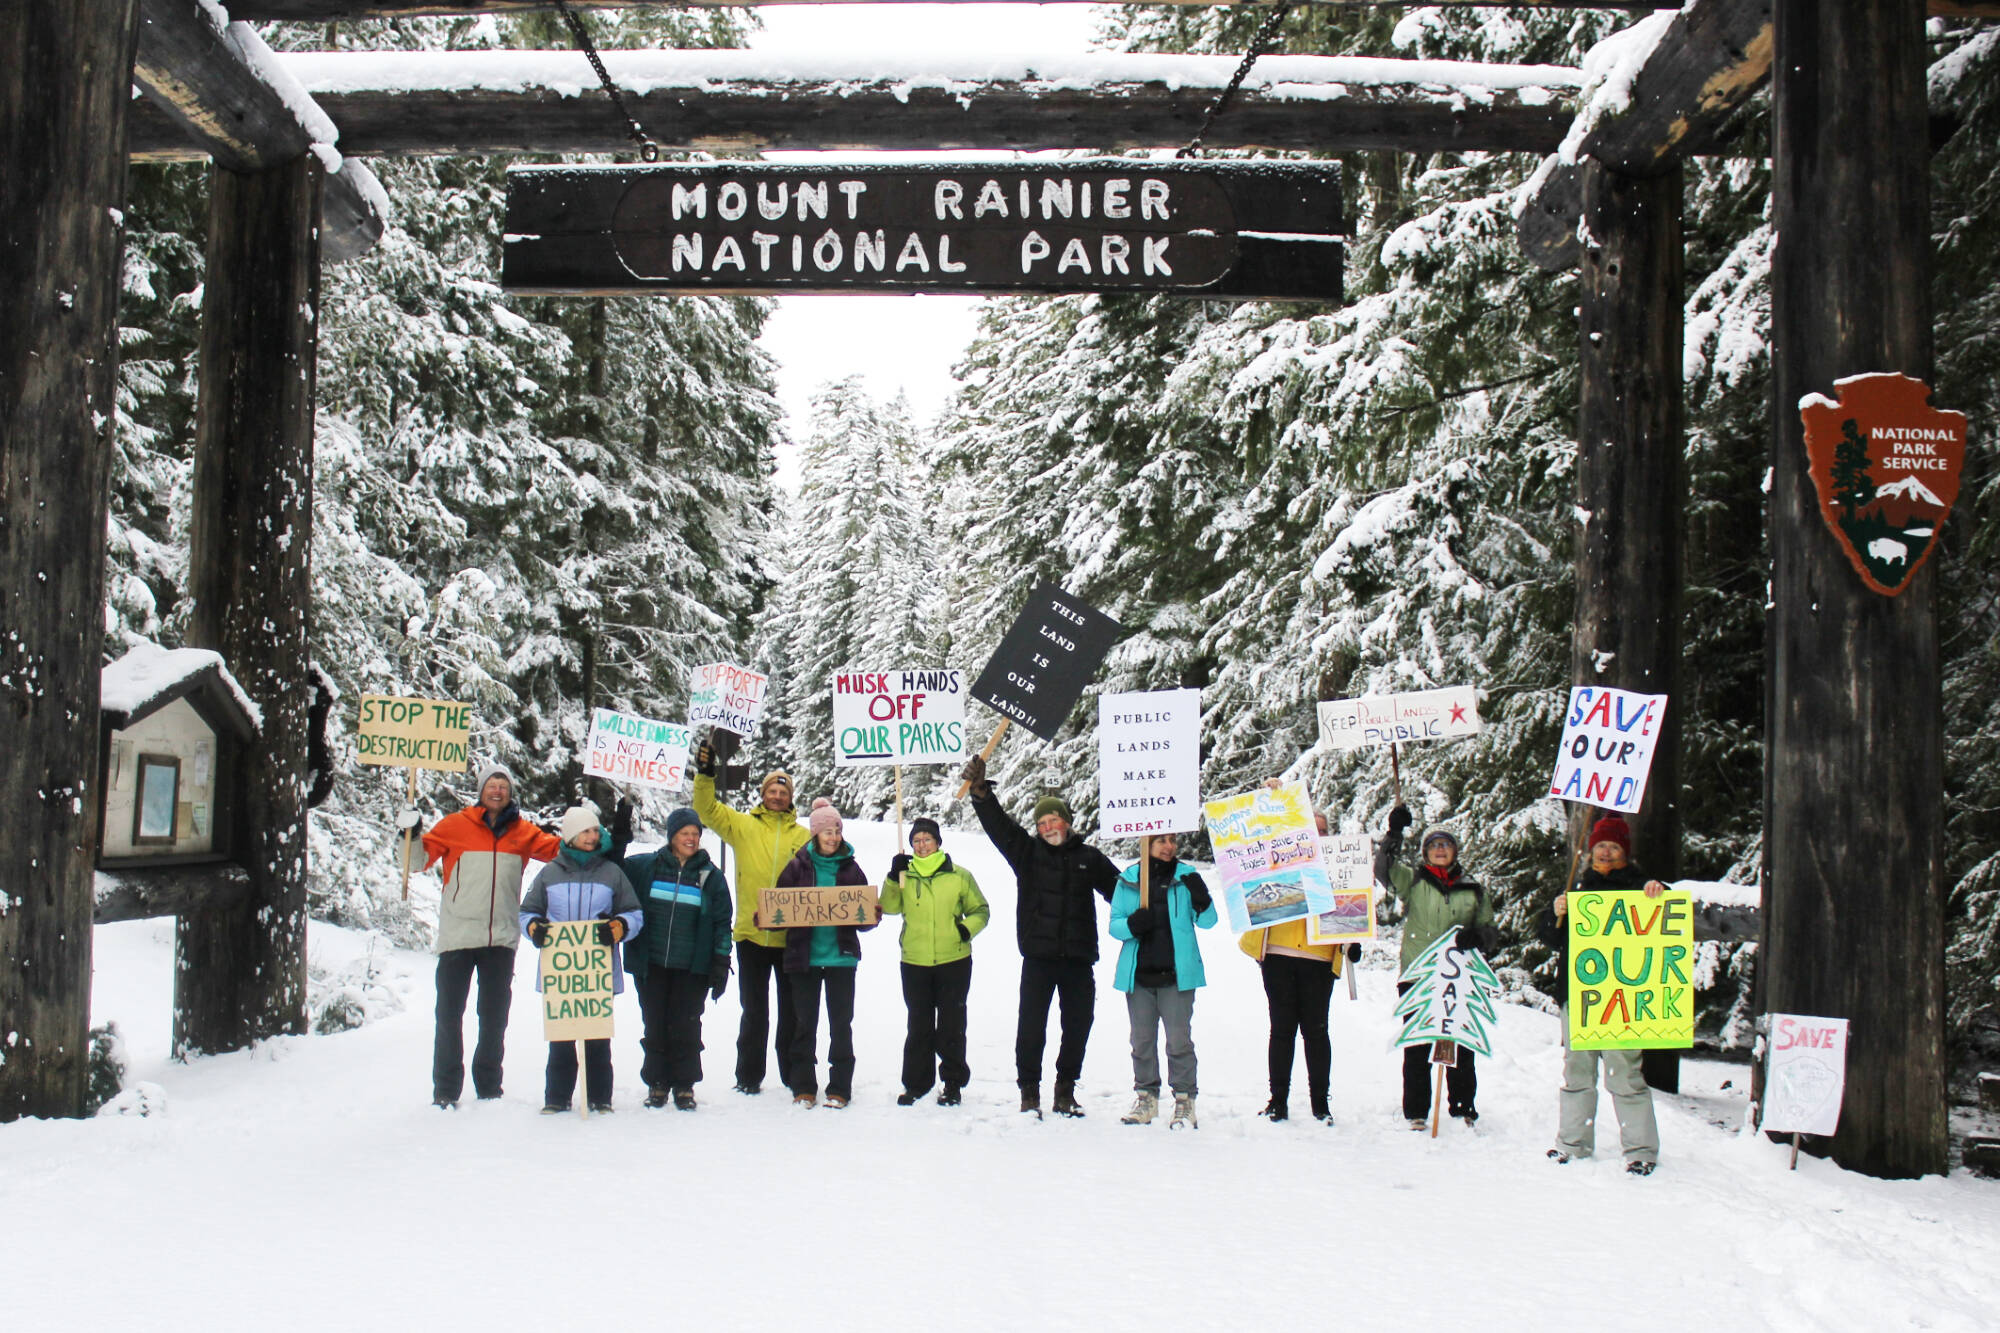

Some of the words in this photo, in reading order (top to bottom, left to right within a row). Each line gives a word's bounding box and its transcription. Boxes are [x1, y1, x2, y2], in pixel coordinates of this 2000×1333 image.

[671, 180, 867, 221] MOUNT
[935, 179, 1170, 220] RAINIER
[671, 228, 966, 272] NATIONAL
[1021, 230, 1173, 275] PARK
[1871, 427, 1958, 441] NATIONAL
[1893, 443, 1937, 455] PARK
[1882, 457, 1948, 470] SERVICE
[1051, 600, 1086, 626] THIS
[1039, 624, 1076, 652] LAND
[1032, 652, 1050, 668] IS
[701, 664, 765, 698] SUPPORT
[837, 673, 889, 694] MUSK
[902, 670, 959, 694] HANDS
[1007, 671, 1037, 694] OUR
[363, 699, 424, 725] STOP
[431, 705, 473, 730] THE
[725, 693, 758, 715] NOT
[868, 693, 926, 721] OFF
[1113, 712, 1172, 724] PUBLIC
[1569, 688, 1657, 736] SAVE
[597, 712, 690, 748] WILDERNESS
[840, 725, 893, 754] OUR
[899, 721, 962, 755] PARKS
[1320, 707, 1356, 744] KEEP
[1364, 718, 1443, 744] PUBLIC
[359, 734, 468, 763] DESTRUCTION
[594, 735, 607, 749] IS
[617, 740, 646, 757] NOT
[655, 748, 667, 763] A
[1117, 740, 1171, 752] LANDS
[1571, 734, 1635, 765] OUR
[592, 751, 681, 787] BUSINESS
[1123, 769, 1167, 780] MAKE
[1106, 796, 1177, 809] AMERICA
[1226, 848, 1245, 860] The
[1247, 840, 1265, 855] rich
[1270, 836, 1294, 850] save
[1296, 832, 1309, 842] on
[764, 890, 824, 914] PROTECT
[839, 890, 869, 903] OUR
[792, 903, 849, 921] PARKS
[1576, 893, 1687, 937] SAVE
[542, 922, 602, 948] SAVE
[552, 949, 607, 971] OUR
[1575, 945, 1688, 986] OUR
[1441, 946, 1465, 1034] SAVE
[546, 997, 613, 1020] LANDS
[1581, 987, 1685, 1027] PARK
[1775, 1019, 1838, 1050] SAVE
